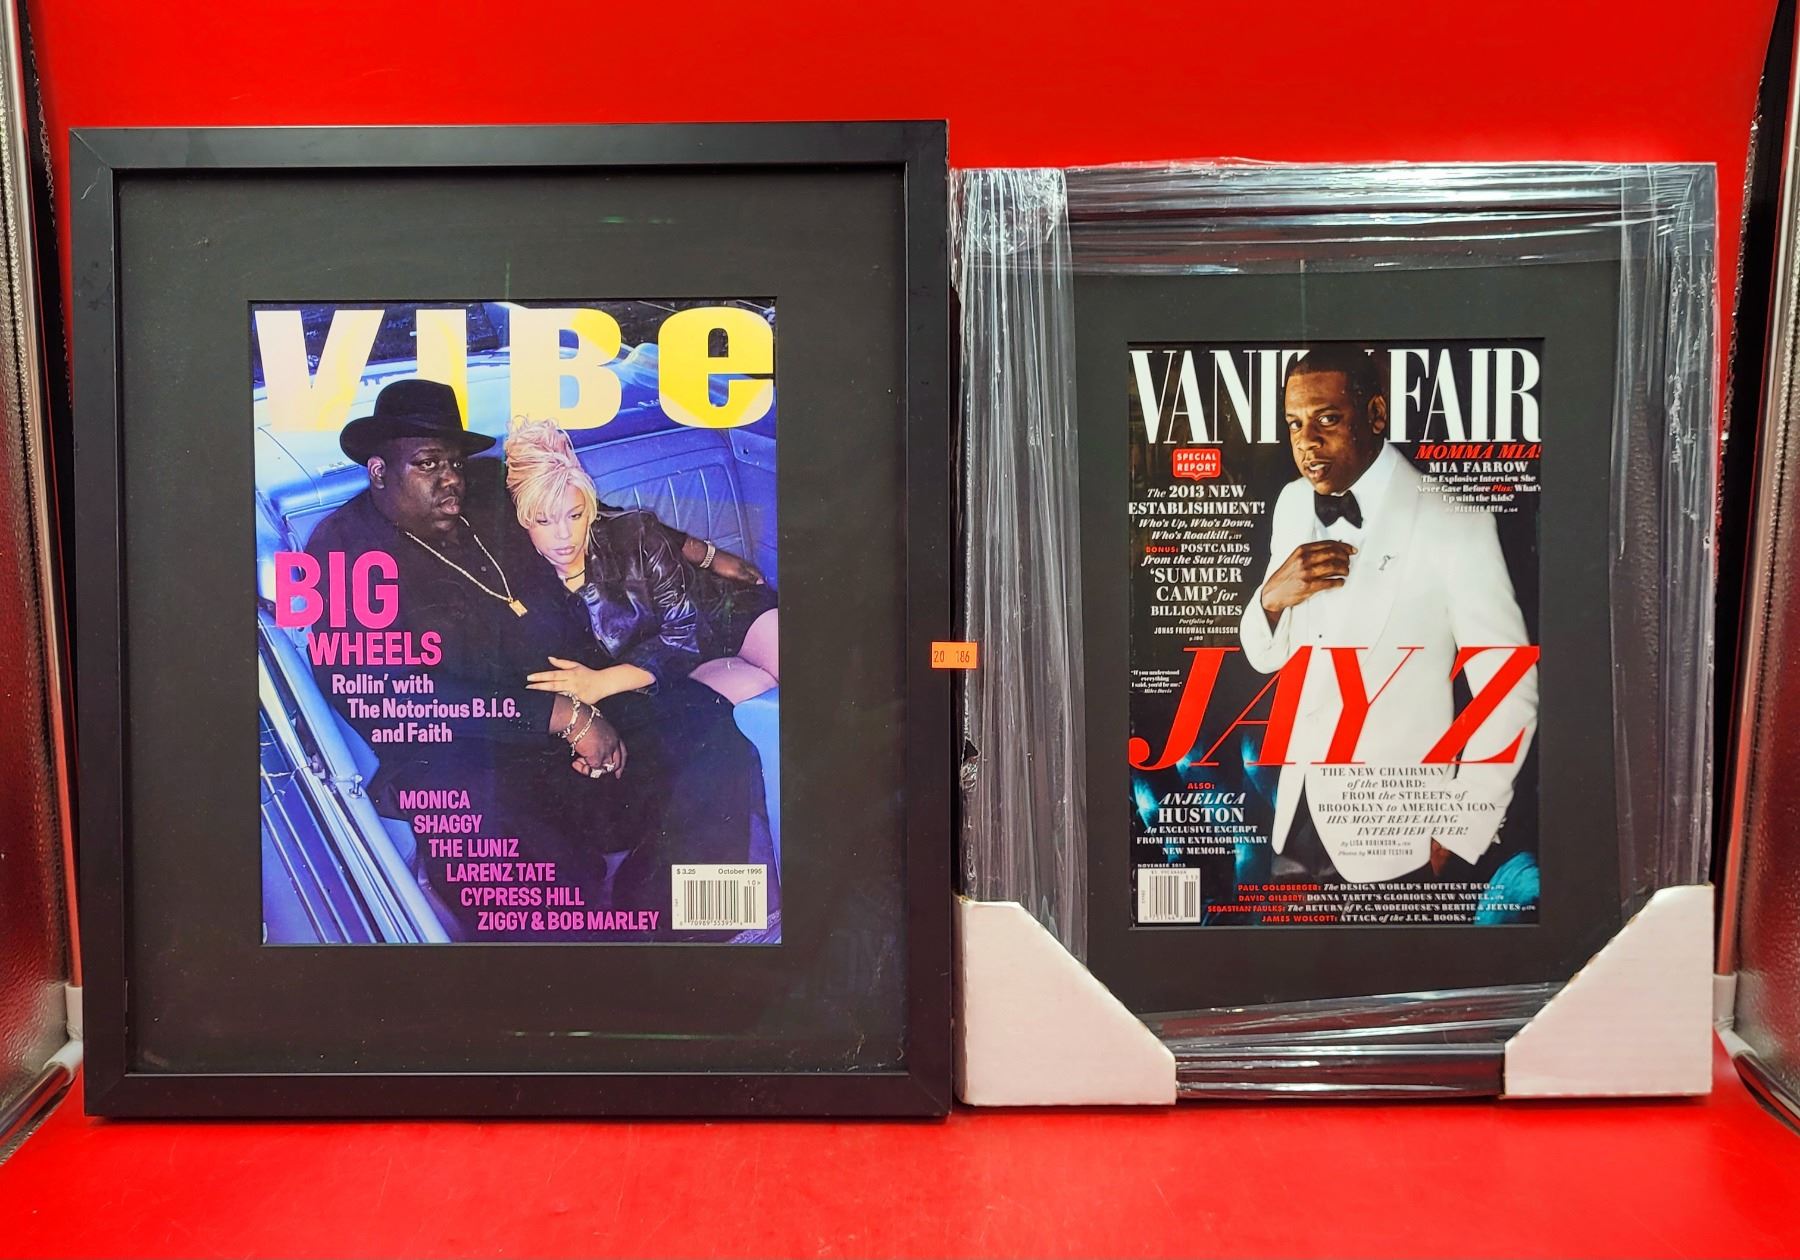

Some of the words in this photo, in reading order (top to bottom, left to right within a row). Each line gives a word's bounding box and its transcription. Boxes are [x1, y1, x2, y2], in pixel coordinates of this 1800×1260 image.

[1129, 349, 1375, 444] VANI
[1387, 348, 1541, 443] FAIR
[1415, 444, 1494, 459] MOMMA
[1497, 444, 1542, 459] MIA!
[1177, 464, 1216, 472] REPORT
[1429, 462, 1458, 473] MIA
[1463, 461, 1529, 473] FARROW
[1147, 488, 1166, 498] The
[1169, 485, 1204, 498] 2013
[1208, 485, 1246, 497] NEW
[1128, 502, 1266, 514] ESTABLISHMENT!
[1138, 518, 1169, 528] Who's
[1171, 519, 1188, 530] Up,
[1190, 518, 1220, 528] Who's
[1222, 518, 1254, 528] Down,
[1152, 531, 1182, 540] Who's
[1183, 530, 1228, 540] Roadkill
[1180, 544, 1250, 553] POSTCARDS
[1140, 555, 1171, 566] from
[1173, 555, 1189, 564] the
[1192, 555, 1215, 564] Sun
[1217, 554, 1252, 566] Valley
[273, 550, 399, 630] BIG
[1213, 590, 1238, 604] for
[1151, 606, 1243, 616] BILLIONAIRES
[306, 631, 442, 666] WHEELS
[934, 650, 945, 662] 20
[332, 674, 389, 694] Rollin'
[392, 674, 434, 694] with
[347, 698, 380, 718] The
[382, 698, 470, 718] Notorious
[472, 698, 522, 718] B.I.G.
[1128, 645, 1425, 771] JAY
[1420, 645, 1540, 764] Z
[371, 722, 405, 742] and
[407, 722, 453, 742] Faith
[1320, 768, 1346, 776] THE
[1349, 768, 1377, 776] NEW
[1379, 767, 1444, 776] CHAIRMAN
[1347, 779, 1362, 789] of
[1361, 780, 1378, 788] the
[1381, 780, 1426, 788] BOARD:
[400, 790, 471, 810] MONICA
[1158, 792, 1246, 805] ANJELICA
[1342, 792, 1376, 800] FROM
[1378, 792, 1396, 800] the
[1398, 791, 1452, 800] STREETS
[1454, 790, 1468, 801] of
[1318, 804, 1383, 812] BROOKLYN
[1386, 804, 1398, 812] to
[1400, 803, 1463, 812] AMERICAN
[1158, 807, 1245, 824] HUSTON
[1326, 815, 1348, 824] HIS
[1351, 815, 1384, 824] MOST
[1387, 814, 1459, 824] REVEALING
[414, 815, 483, 834] SHAGGY
[1144, 826, 1158, 834] An
[1159, 826, 1212, 834] EXCLUSIVE
[1214, 826, 1258, 834] EXCERPT
[1356, 826, 1427, 836] INTERVIEW
[1430, 826, 1470, 836] EVER!
[1136, 836, 1164, 845] FROM
[1166, 836, 1186, 844] HER
[1188, 836, 1269, 844] EXTRAORDINARY
[428, 838, 463, 858] THE
[467, 838, 520, 858] LUNIZ
[1162, 848, 1183, 856] NEW
[1186, 847, 1226, 856] MEMOIR
[446, 863, 514, 882] LARENZ
[516, 863, 556, 882] TATE
[460, 887, 542, 906] CYPRESS
[546, 887, 585, 906] HILL
[478, 911, 530, 930] ZIGGY
[531, 911, 546, 930] &
[548, 911, 585, 930] BOB
[587, 911, 660, 930] MARLEY
[1378, 914, 1390, 924] of
